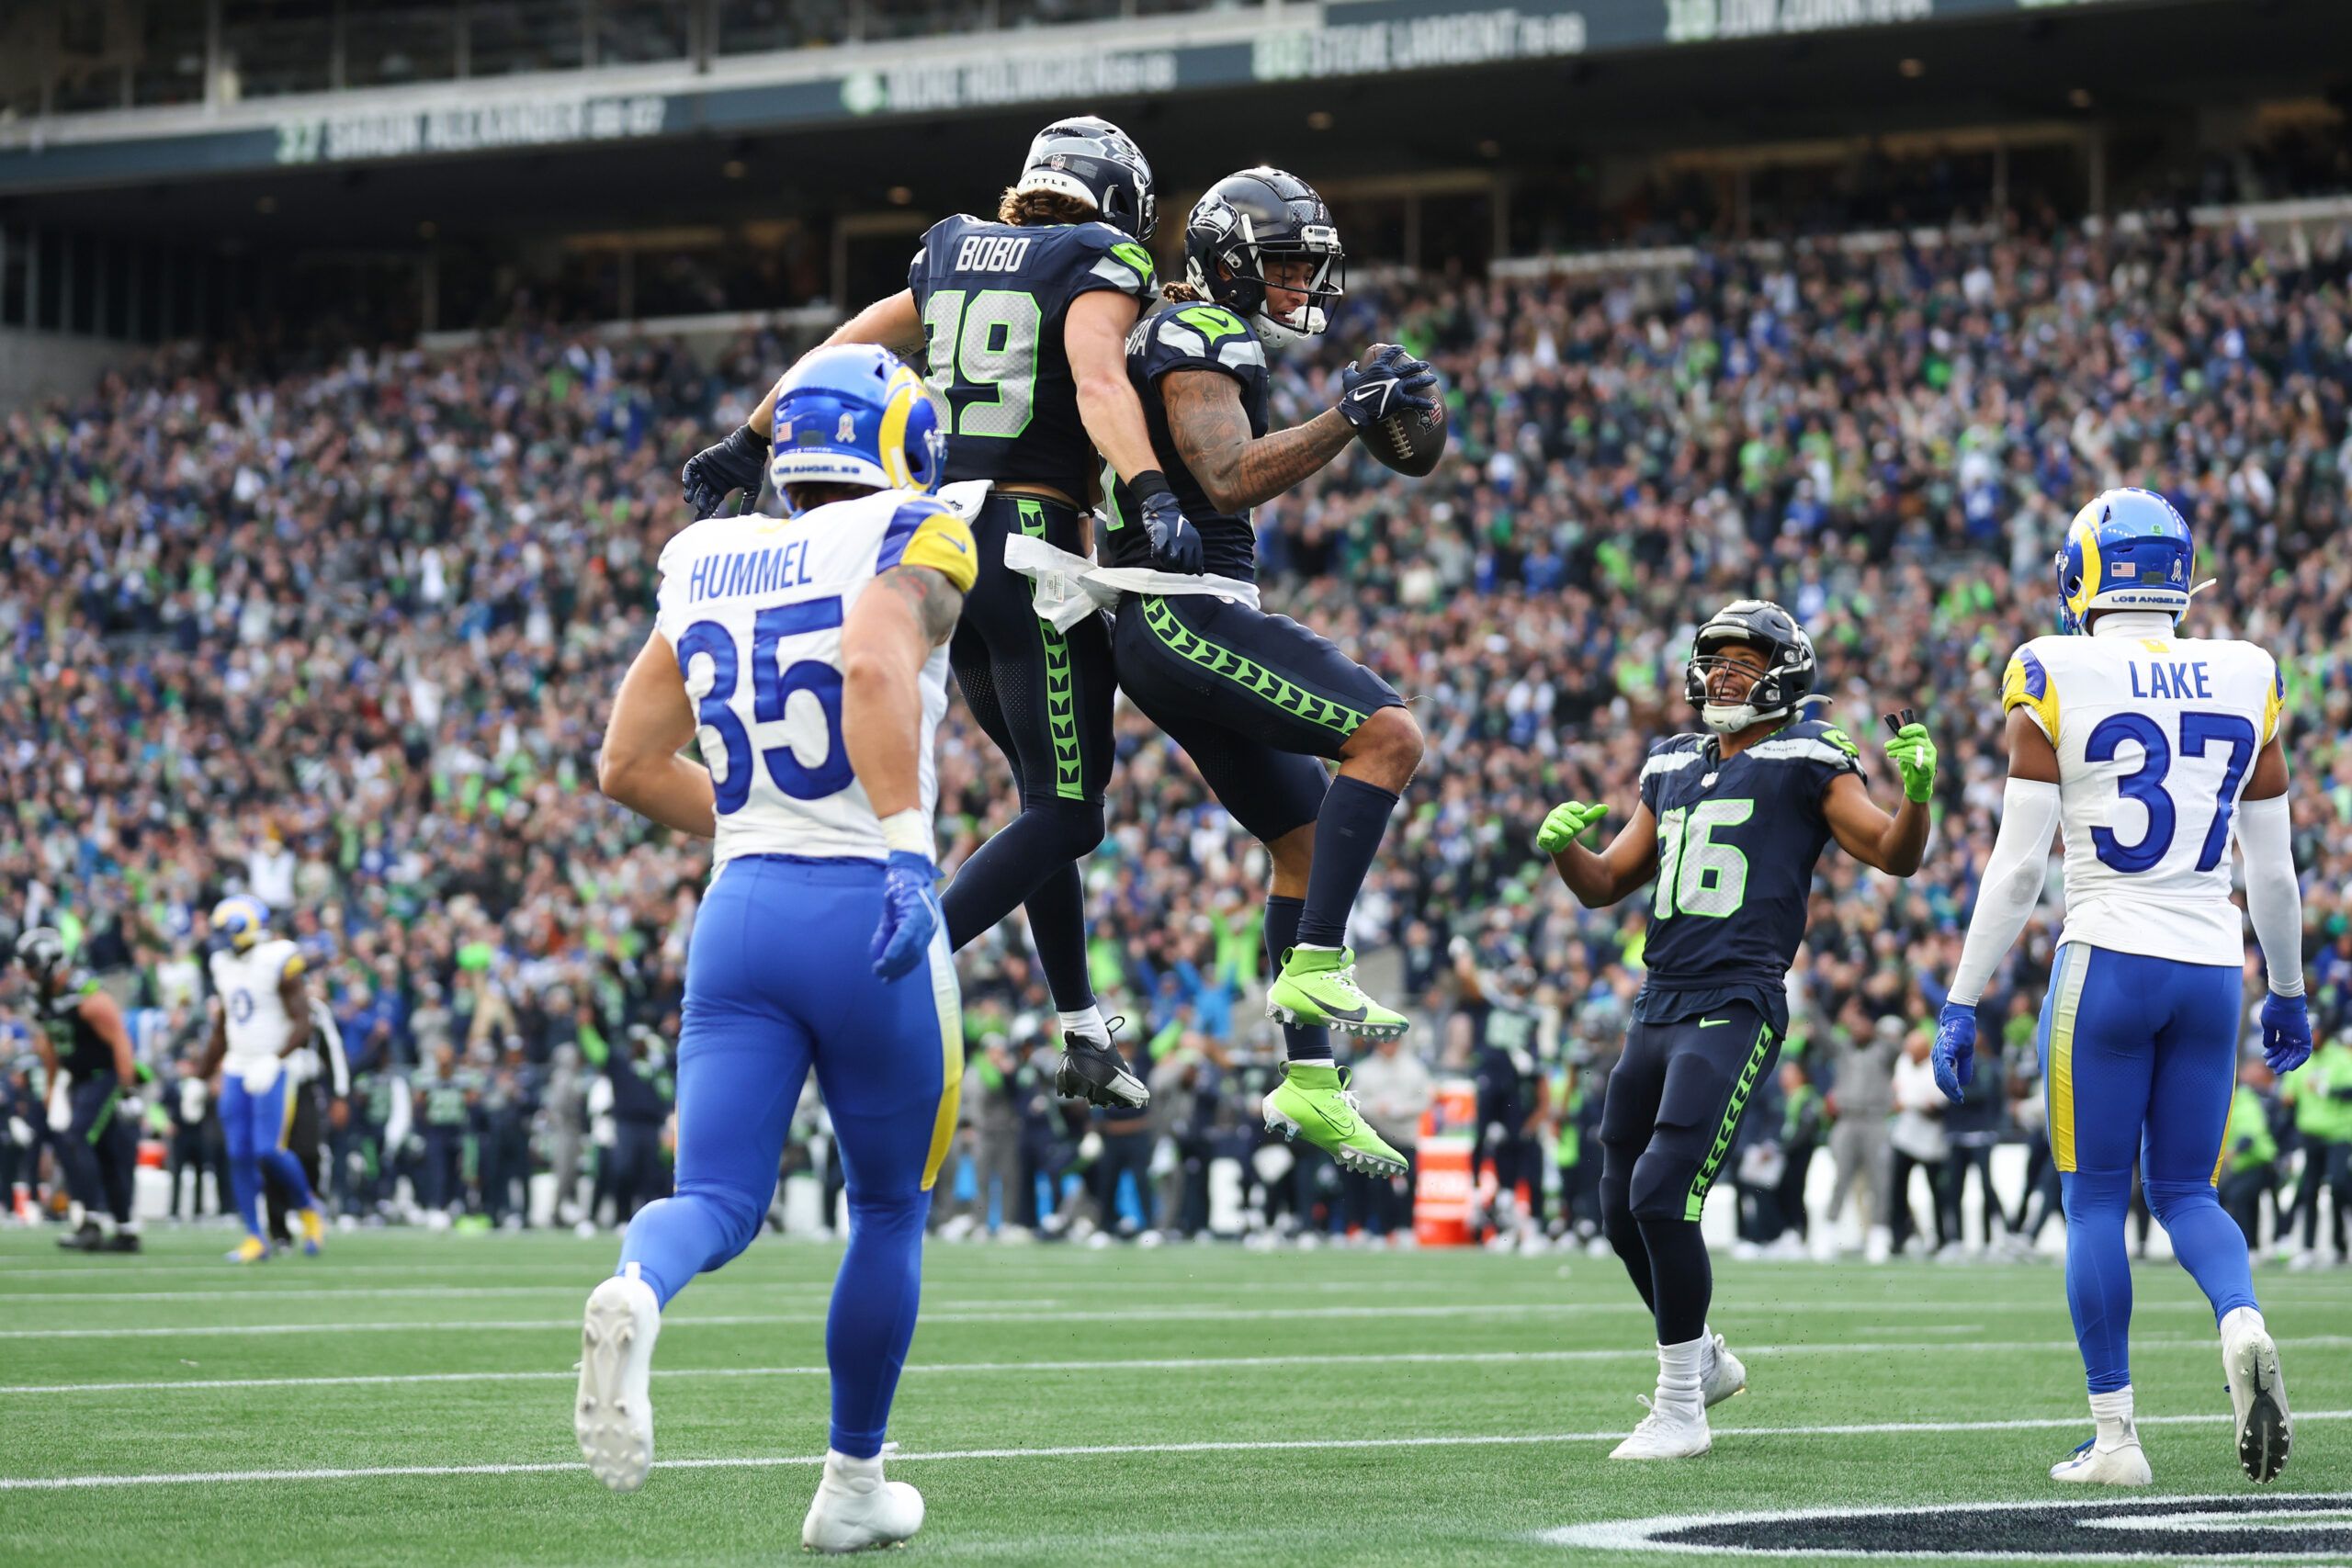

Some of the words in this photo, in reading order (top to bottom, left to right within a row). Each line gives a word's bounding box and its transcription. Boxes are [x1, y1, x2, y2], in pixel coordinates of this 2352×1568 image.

[1026, 178, 1068, 187] ATTLE
[955, 235, 1031, 273] BOBO
[923, 289, 1042, 438] 19
[690, 540, 812, 604] HUMMEL
[2111, 595, 2136, 604] LOS
[2139, 595, 2187, 604] ANGELES
[677, 594, 855, 815] 35
[2128, 660, 2212, 699] LAKE
[2085, 711, 2256, 874] 37
[1655, 798, 1755, 920] 16
